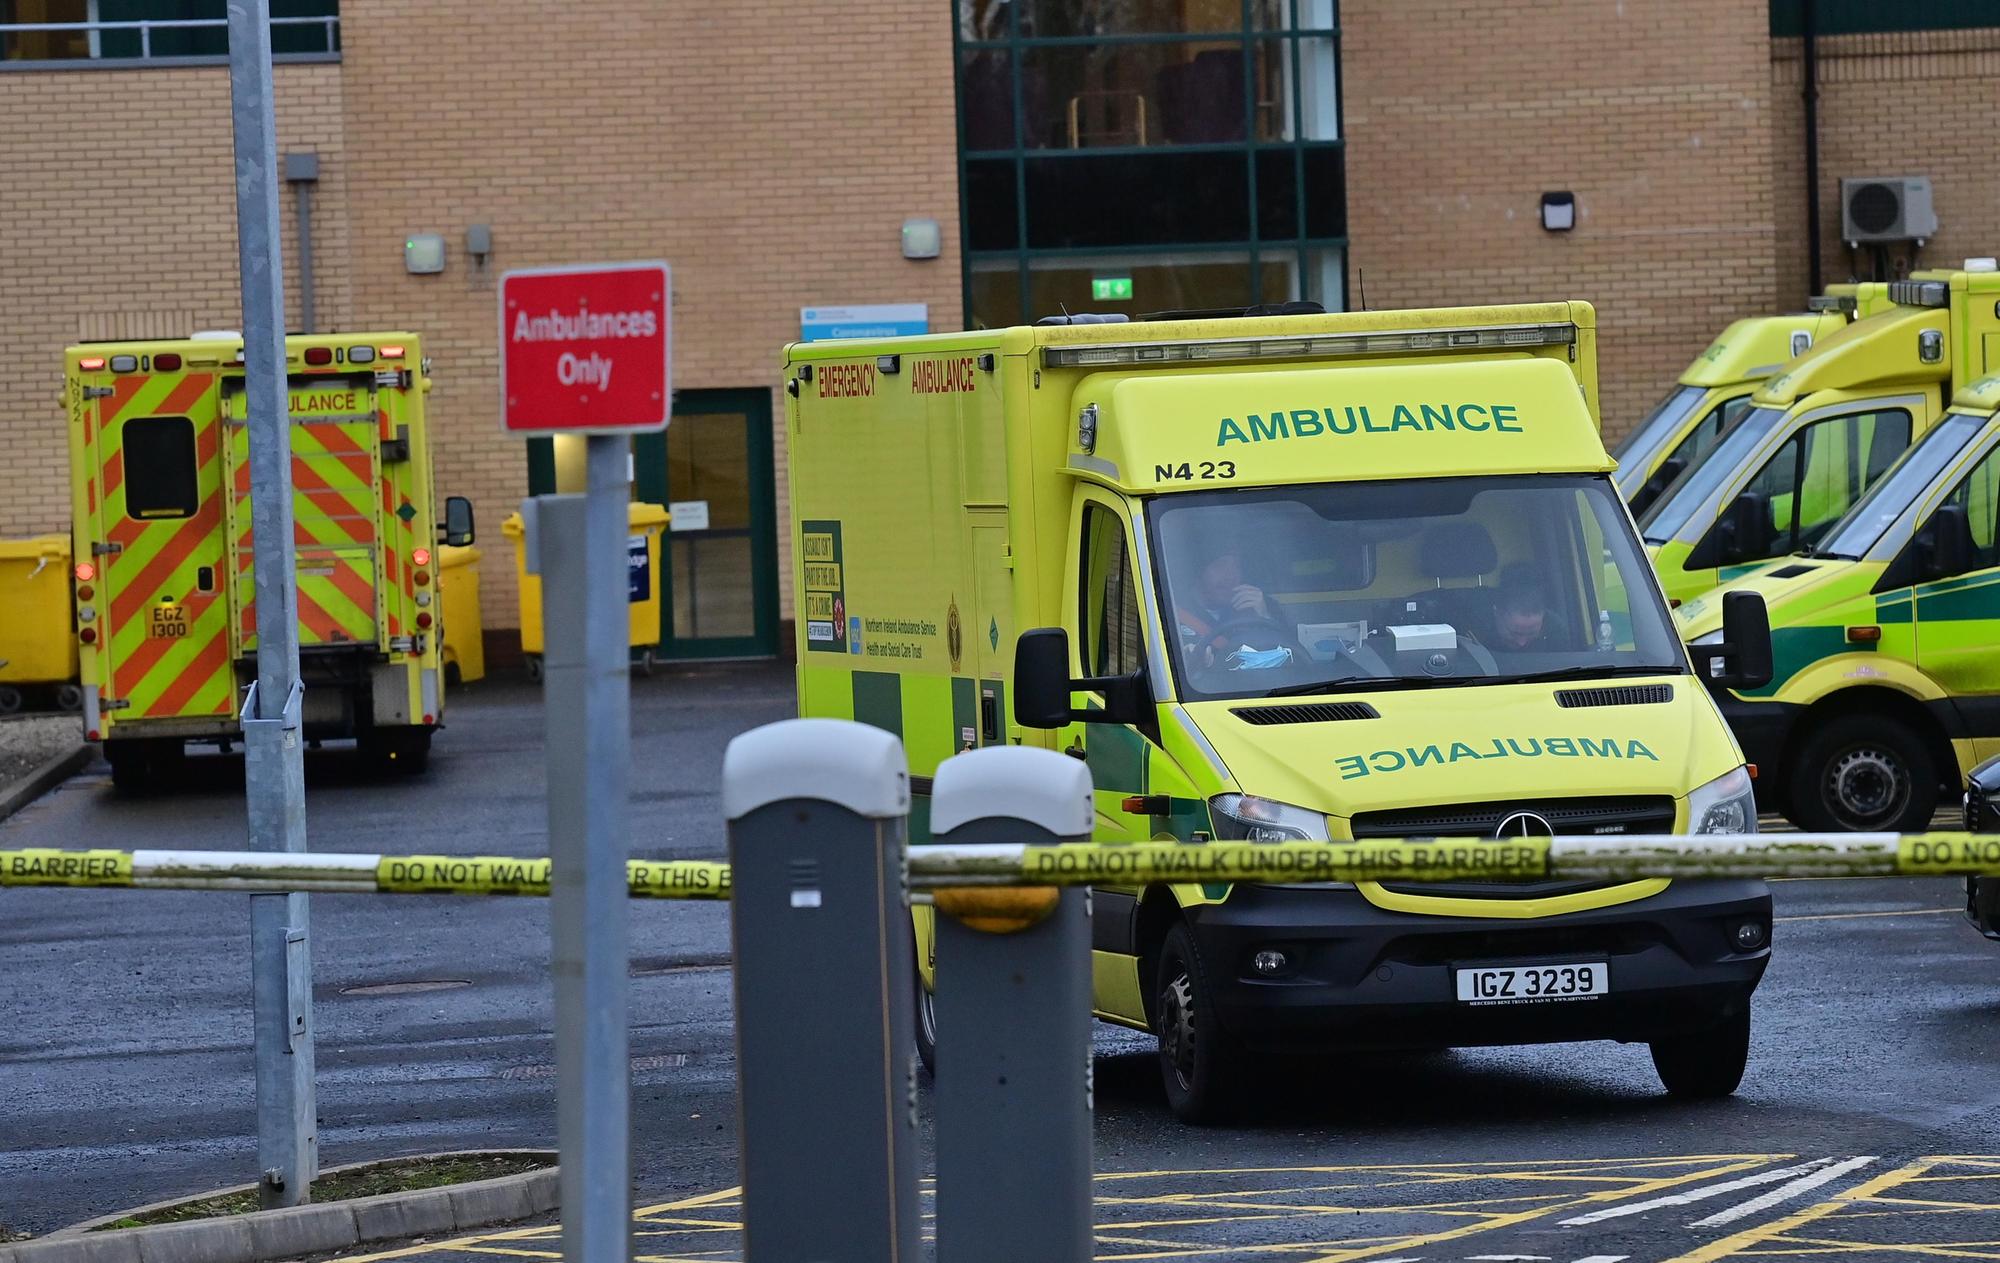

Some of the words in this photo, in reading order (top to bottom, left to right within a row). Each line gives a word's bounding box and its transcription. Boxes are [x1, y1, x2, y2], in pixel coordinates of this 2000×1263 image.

[513, 308, 657, 342] Ambulances
[557, 352, 613, 392] Only
[818, 363, 876, 398] EMERGENCY
[911, 357, 975, 394] AMBULANCE
[287, 393, 356, 412] ULANCE
[1217, 403, 1524, 447] AMBULANCE
[153, 607, 183, 621] EGZ
[152, 623, 186, 637] 1300
[865, 618, 882, 632] Northern
[883, 618, 897, 633] Ireland
[898, 619, 920, 635] Ambulance
[920, 620, 937, 636] Service
[866, 642, 879, 656] Health
[888, 642, 900, 657] Social
[901, 643, 911, 658] Care
[911, 643, 922, 659] Trust
[1038, 852, 1078, 873] DO
[1086, 852, 1143, 873] NOT
[1150, 851, 1228, 873] WALK
[1238, 849, 1332, 872] UNDER
[1343, 848, 1402, 869] THIS
[1411, 846, 1536, 869] BARRIER
[1912, 842, 1952, 864] DO
[1963, 841, 2000, 864] NO
[12, 856, 119, 878] BARRIER
[390, 862, 424, 883] DO
[432, 863, 483, 884] NOT
[659, 868, 709, 888] THIS
[1473, 971, 1516, 998] IGZ
[1525, 967, 1593, 996] 3239
